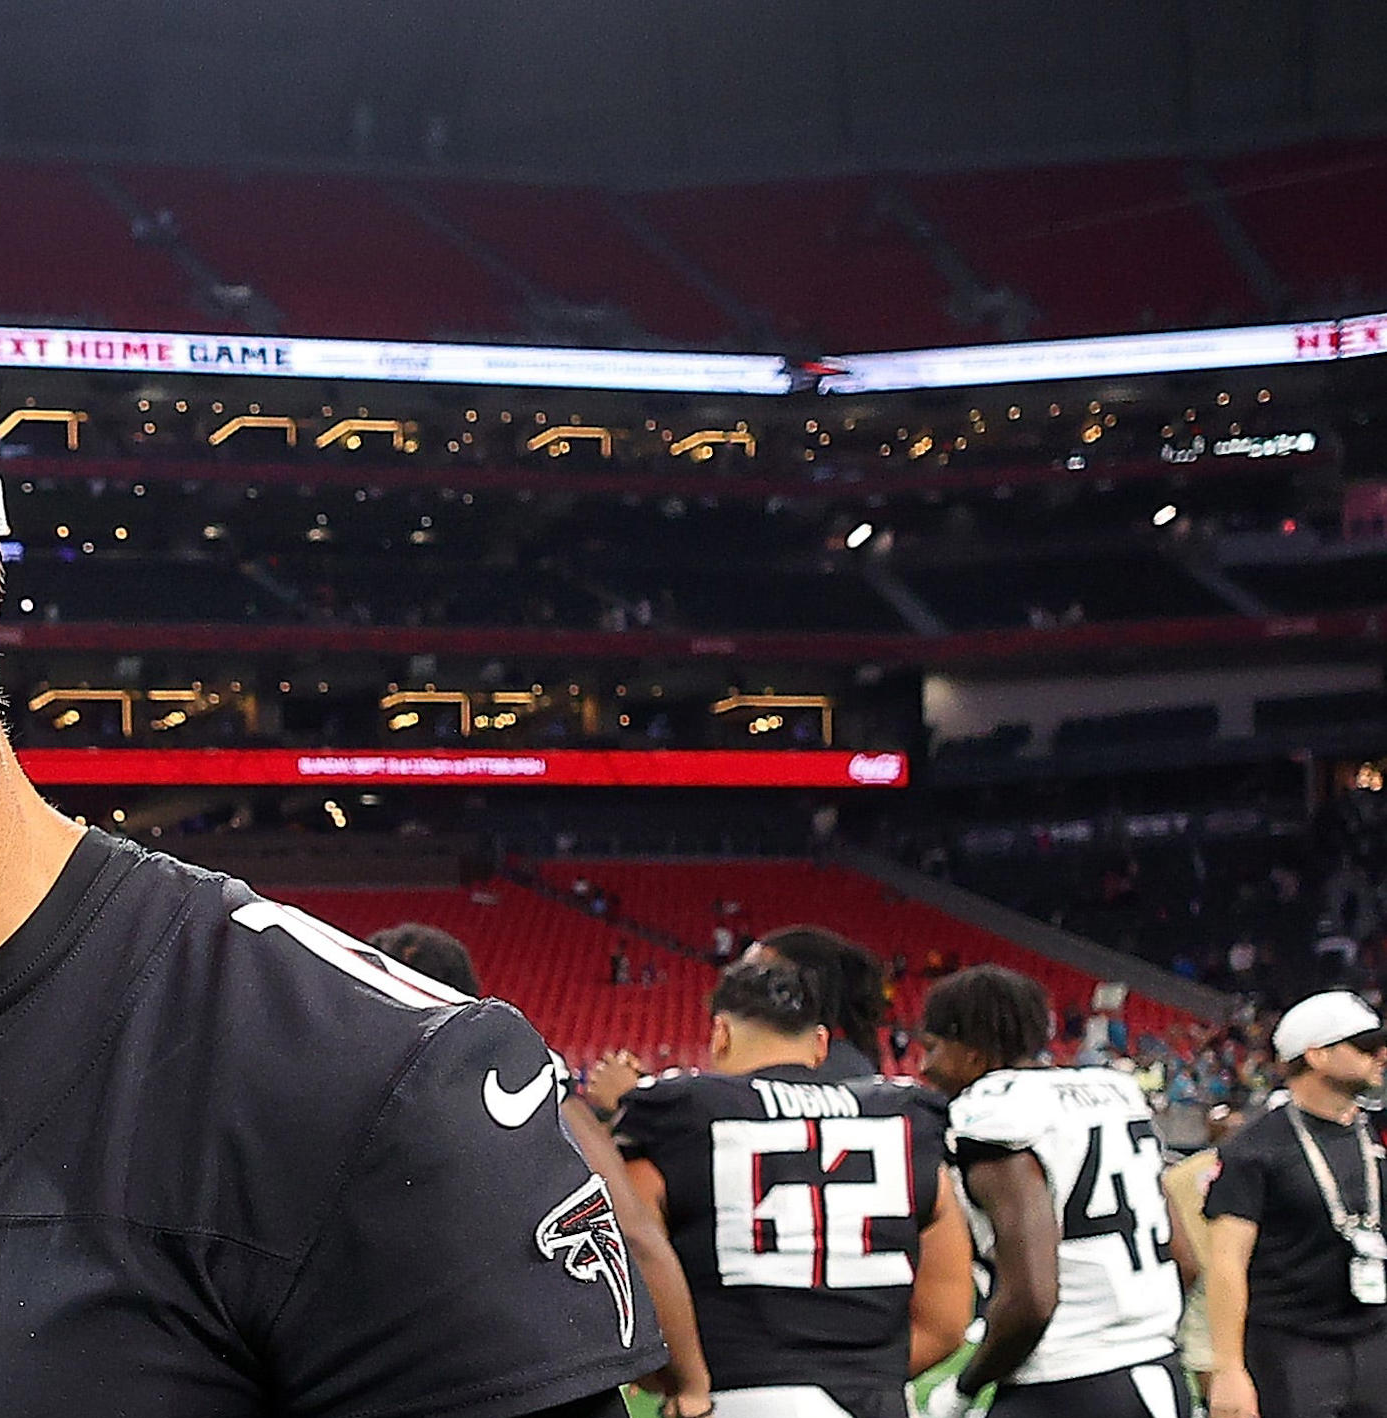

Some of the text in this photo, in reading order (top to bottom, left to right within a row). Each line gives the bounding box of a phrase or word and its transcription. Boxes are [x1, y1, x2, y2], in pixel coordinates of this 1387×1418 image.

[67, 338, 173, 362] HOME
[188, 343, 294, 367] GAME
[710, 1114, 918, 1290] 62
